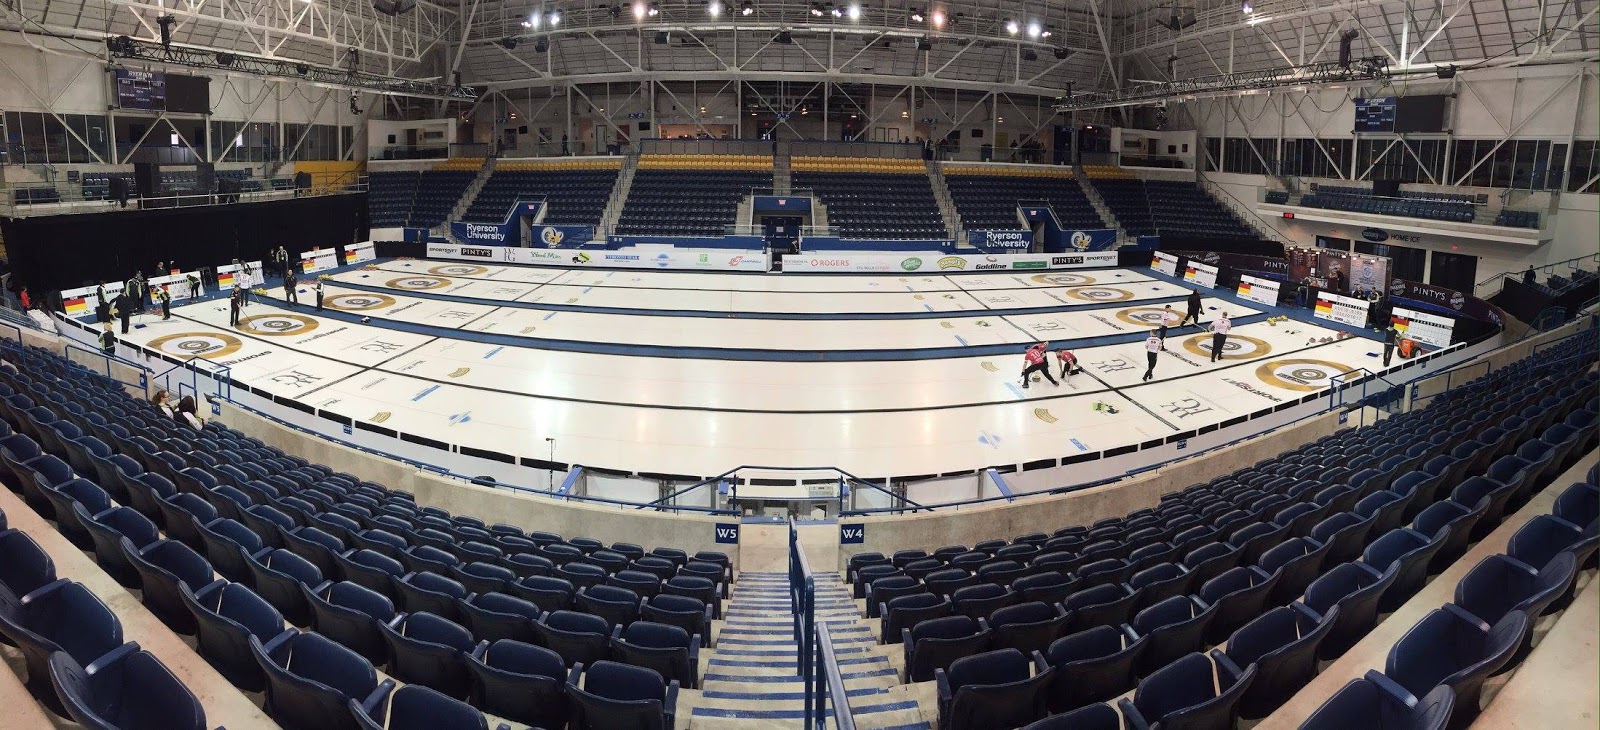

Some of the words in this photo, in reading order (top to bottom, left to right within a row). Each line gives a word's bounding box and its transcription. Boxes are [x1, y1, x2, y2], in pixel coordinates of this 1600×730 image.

[466, 223, 498, 234] Ryerson
[466, 232, 505, 241] University
[986, 231, 1022, 242] Ryerson
[1390, 233, 1409, 242] HOME
[986, 240, 1030, 248] University
[462, 248, 491, 257] PINTY'S
[820, 259, 849, 267] ROGERS
[1053, 256, 1083, 265] PINTY'S
[1413, 286, 1446, 301] PINTY'S
[717, 528, 737, 539] W5
[842, 529, 863, 539] W4
